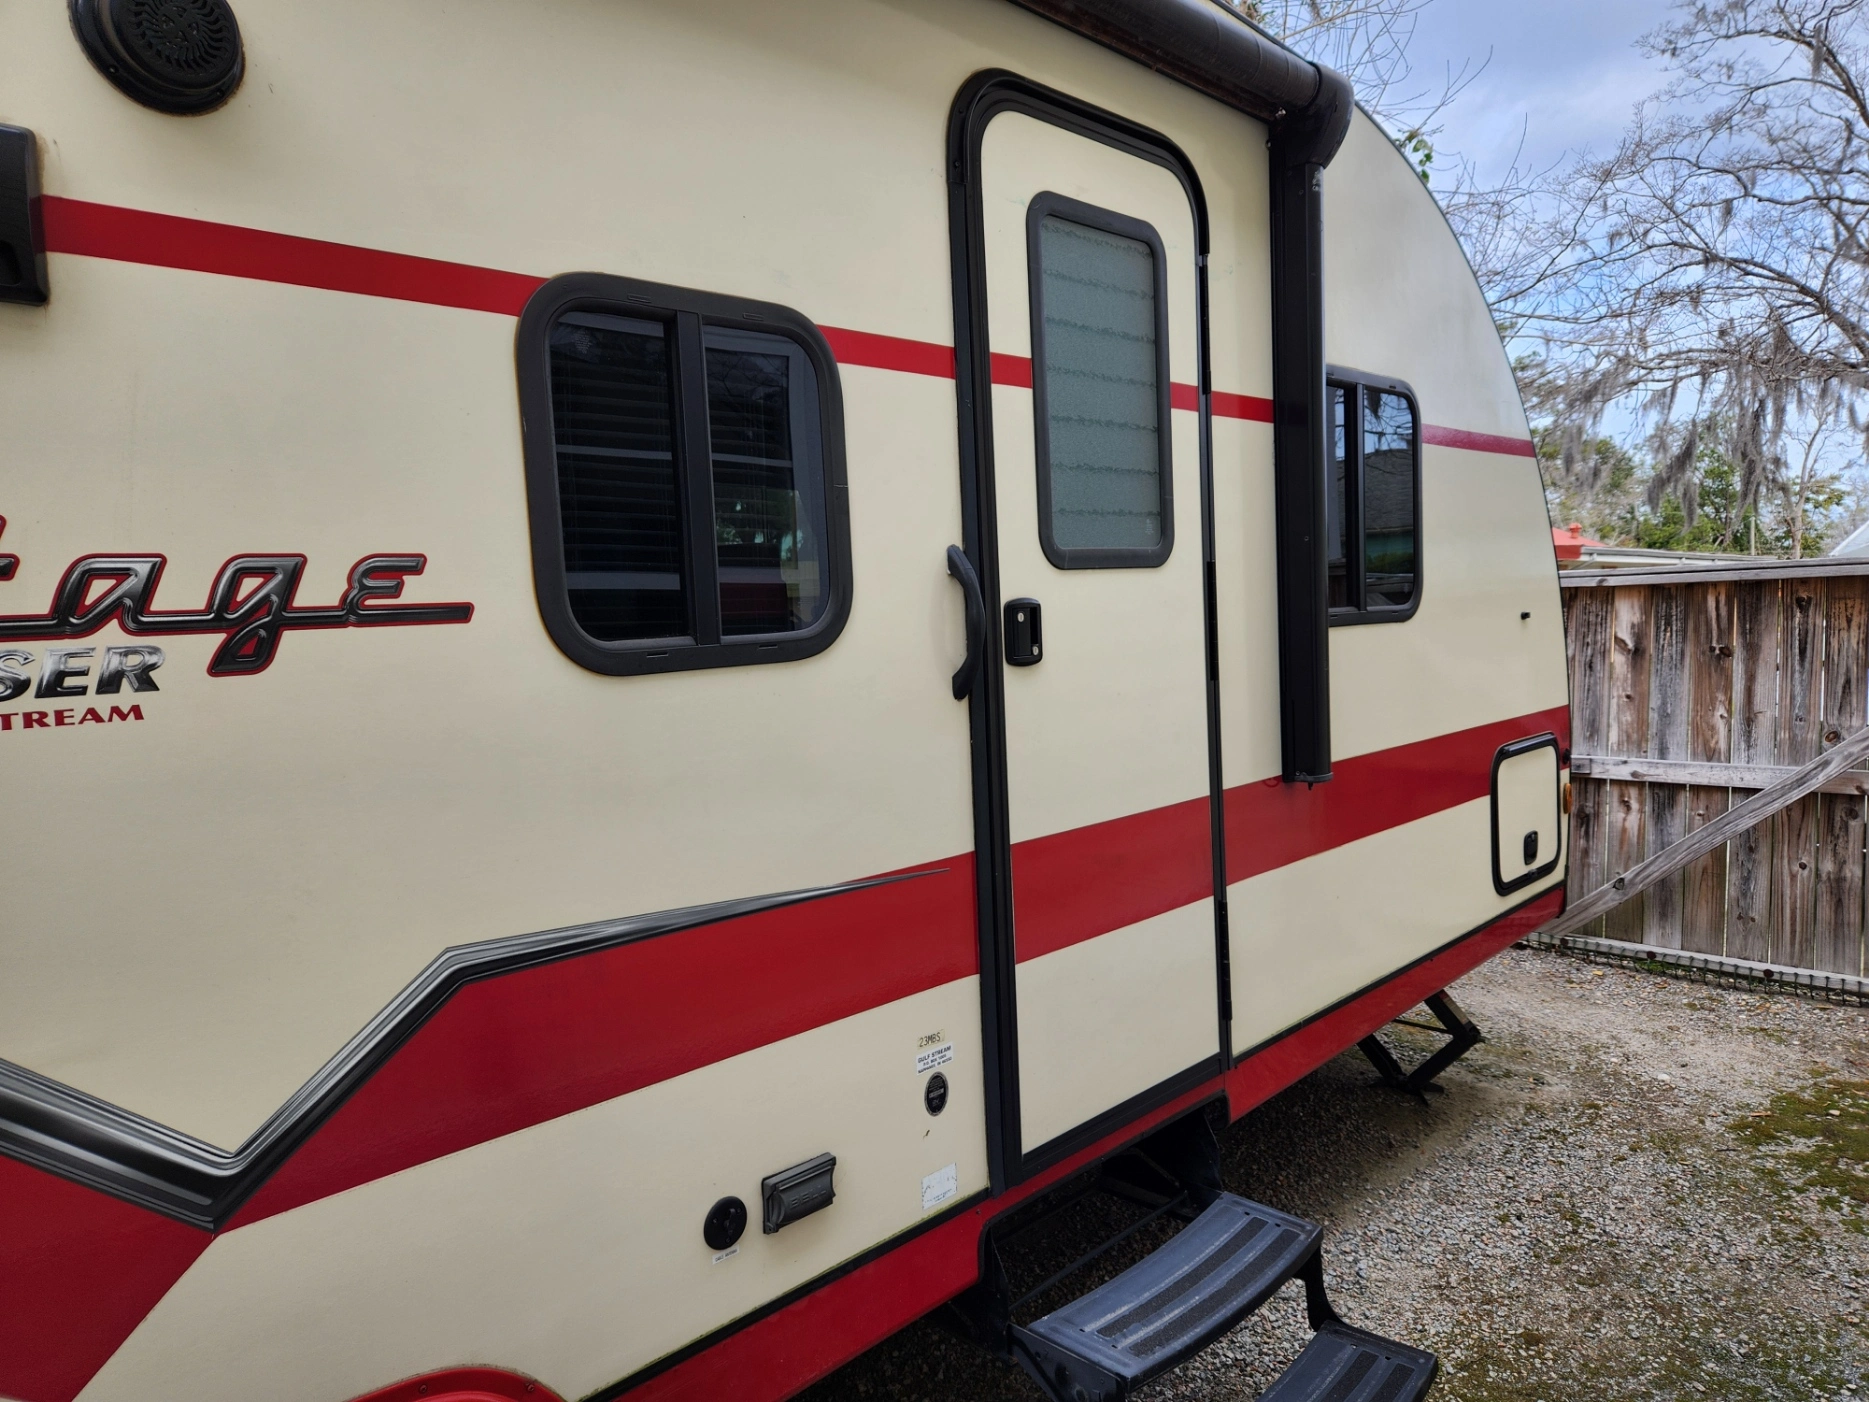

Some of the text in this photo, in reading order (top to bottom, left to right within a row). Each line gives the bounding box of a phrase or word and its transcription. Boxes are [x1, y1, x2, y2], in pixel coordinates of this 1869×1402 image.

[0, 704, 144, 731] TREAM
[919, 1031, 941, 1048] 23MBS
[918, 1053, 930, 1063] GULF
[931, 1045, 951, 1058] STREAM
